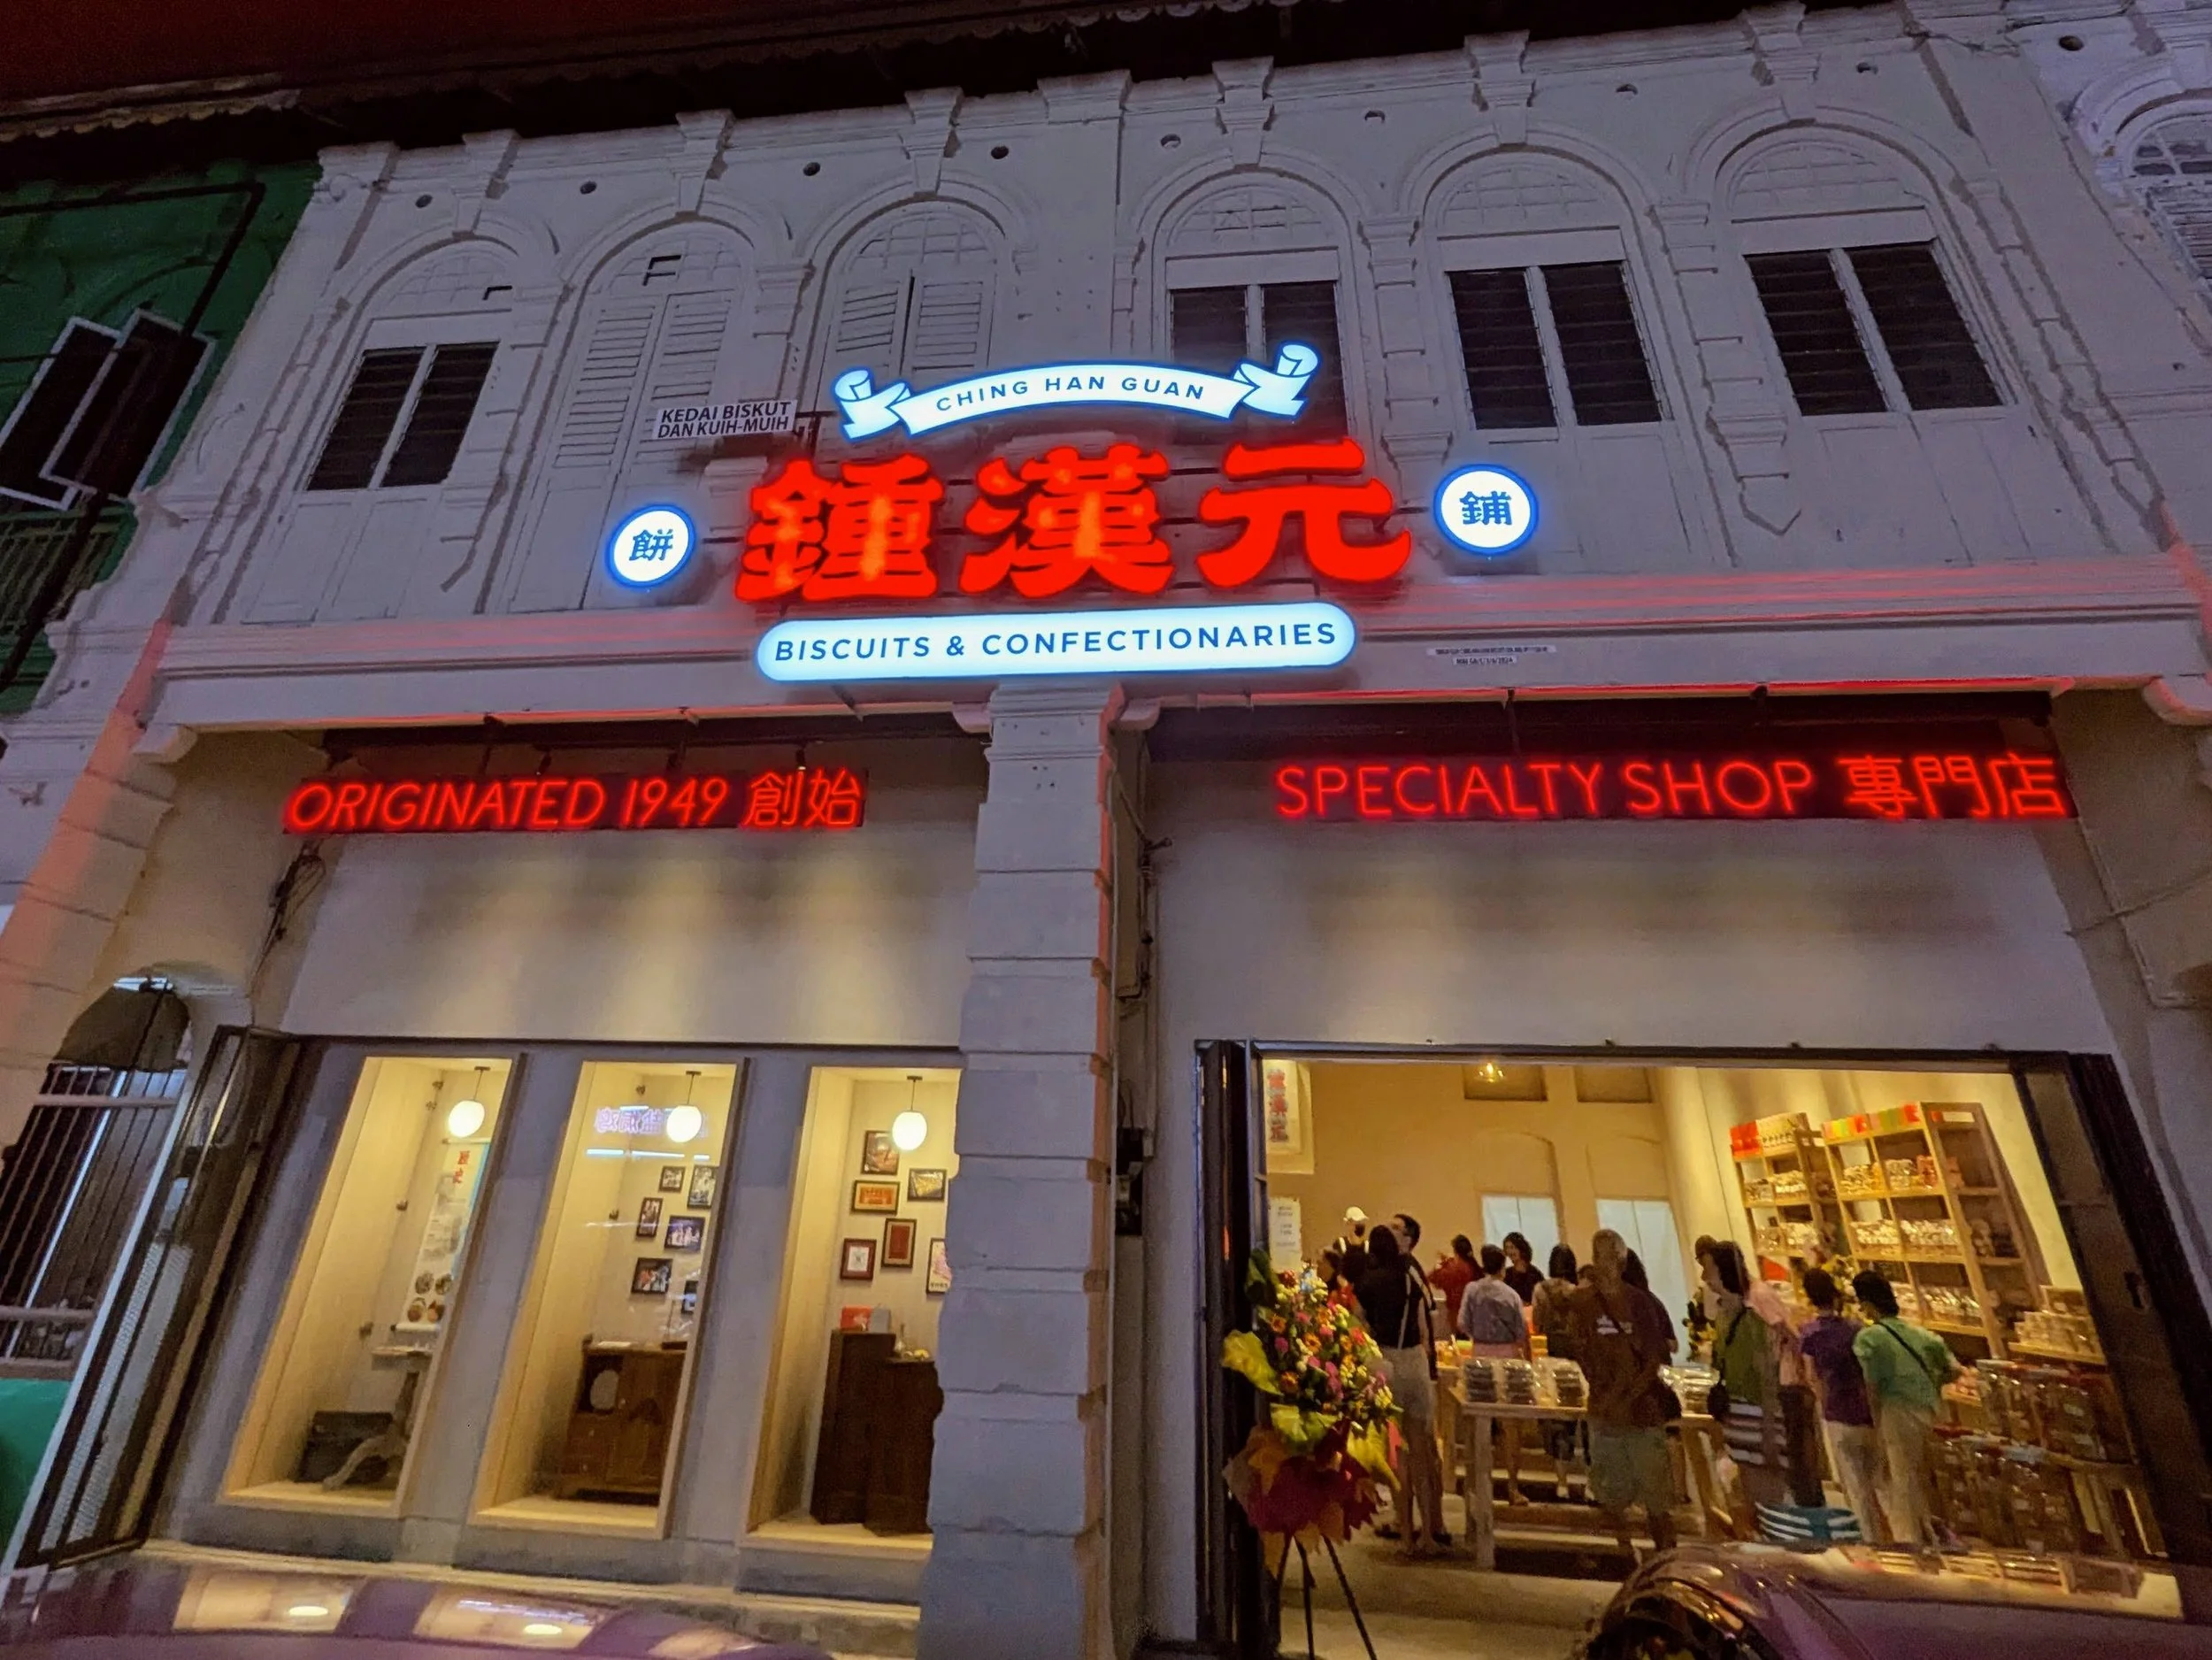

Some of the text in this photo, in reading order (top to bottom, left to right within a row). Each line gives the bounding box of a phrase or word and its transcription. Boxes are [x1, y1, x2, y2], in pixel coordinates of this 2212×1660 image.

[936, 376, 1204, 411] CHING HAN GUAN
[657, 416, 789, 438] DAN KUIH-MUIH
[661, 402, 791, 423] KEDAI BISKUT
[1459, 490, 1513, 526] 鋪
[628, 528, 674, 562] 餅
[775, 623, 1336, 661] BISCUITS & CONFECTIONARIES
[287, 769, 862, 830] ORIGINATED 1949 創始
[1275, 754, 2068, 818] SPECIALTY SHOP 專門店
